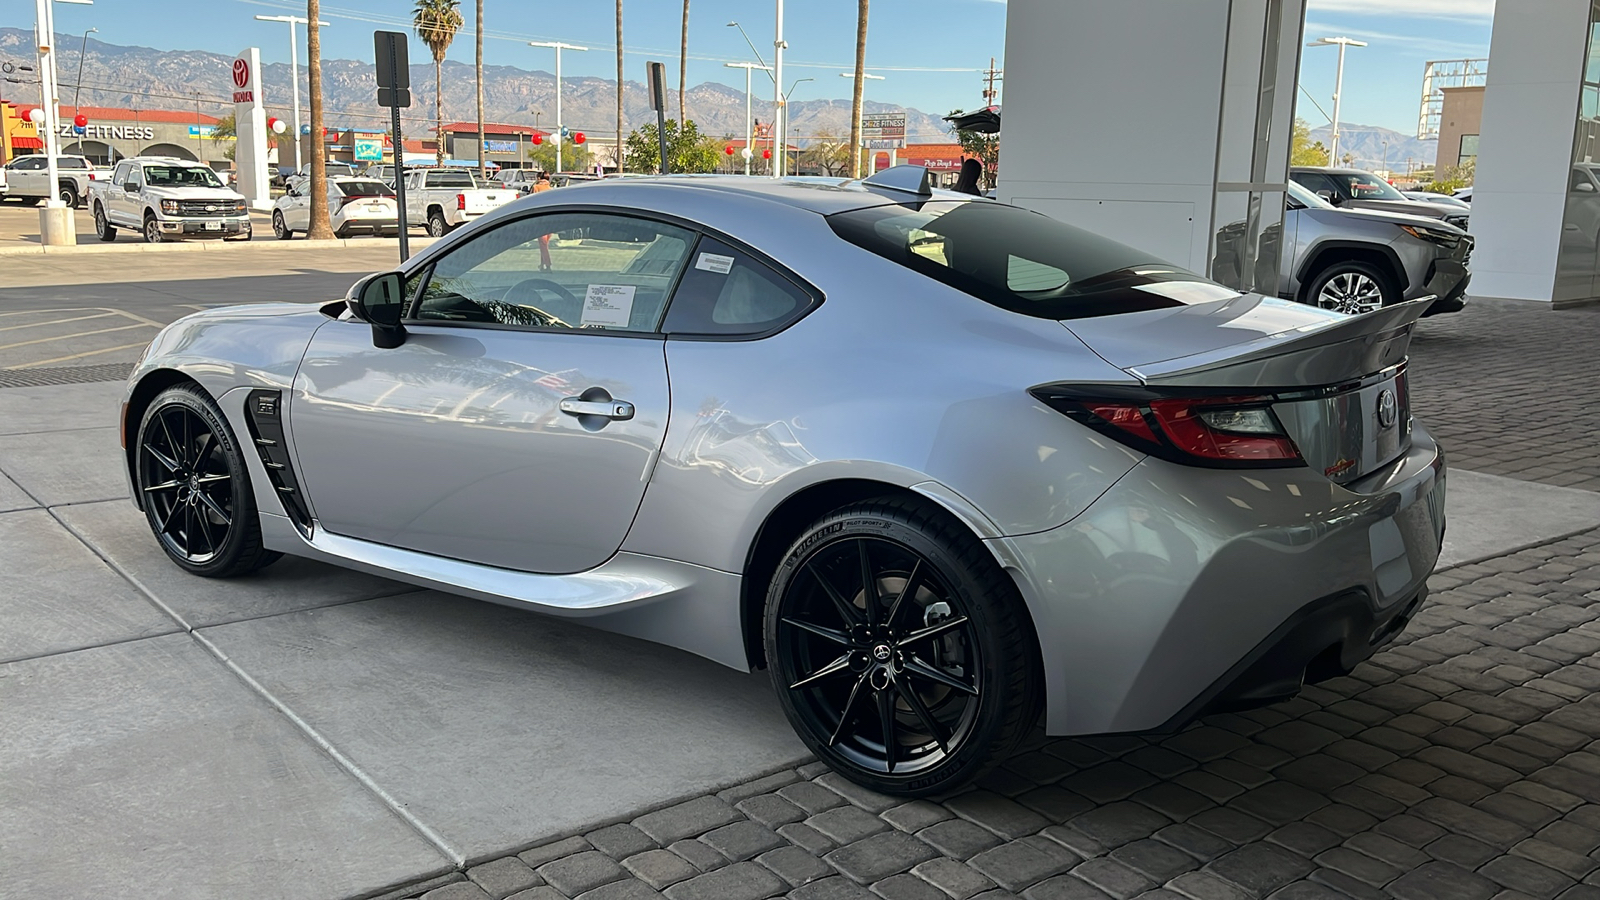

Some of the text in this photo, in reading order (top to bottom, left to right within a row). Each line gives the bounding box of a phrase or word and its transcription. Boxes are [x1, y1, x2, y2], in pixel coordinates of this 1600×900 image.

[881, 119, 904, 128] FITNESS
[86, 124, 154, 140] FITNESS
[869, 139, 893, 149] Goodwill
[924, 159, 936, 168] Pep
[936, 159, 952, 169] Boys
[207, 413, 231, 450] MICHELIN
[796, 522, 841, 556] MICHELIN
